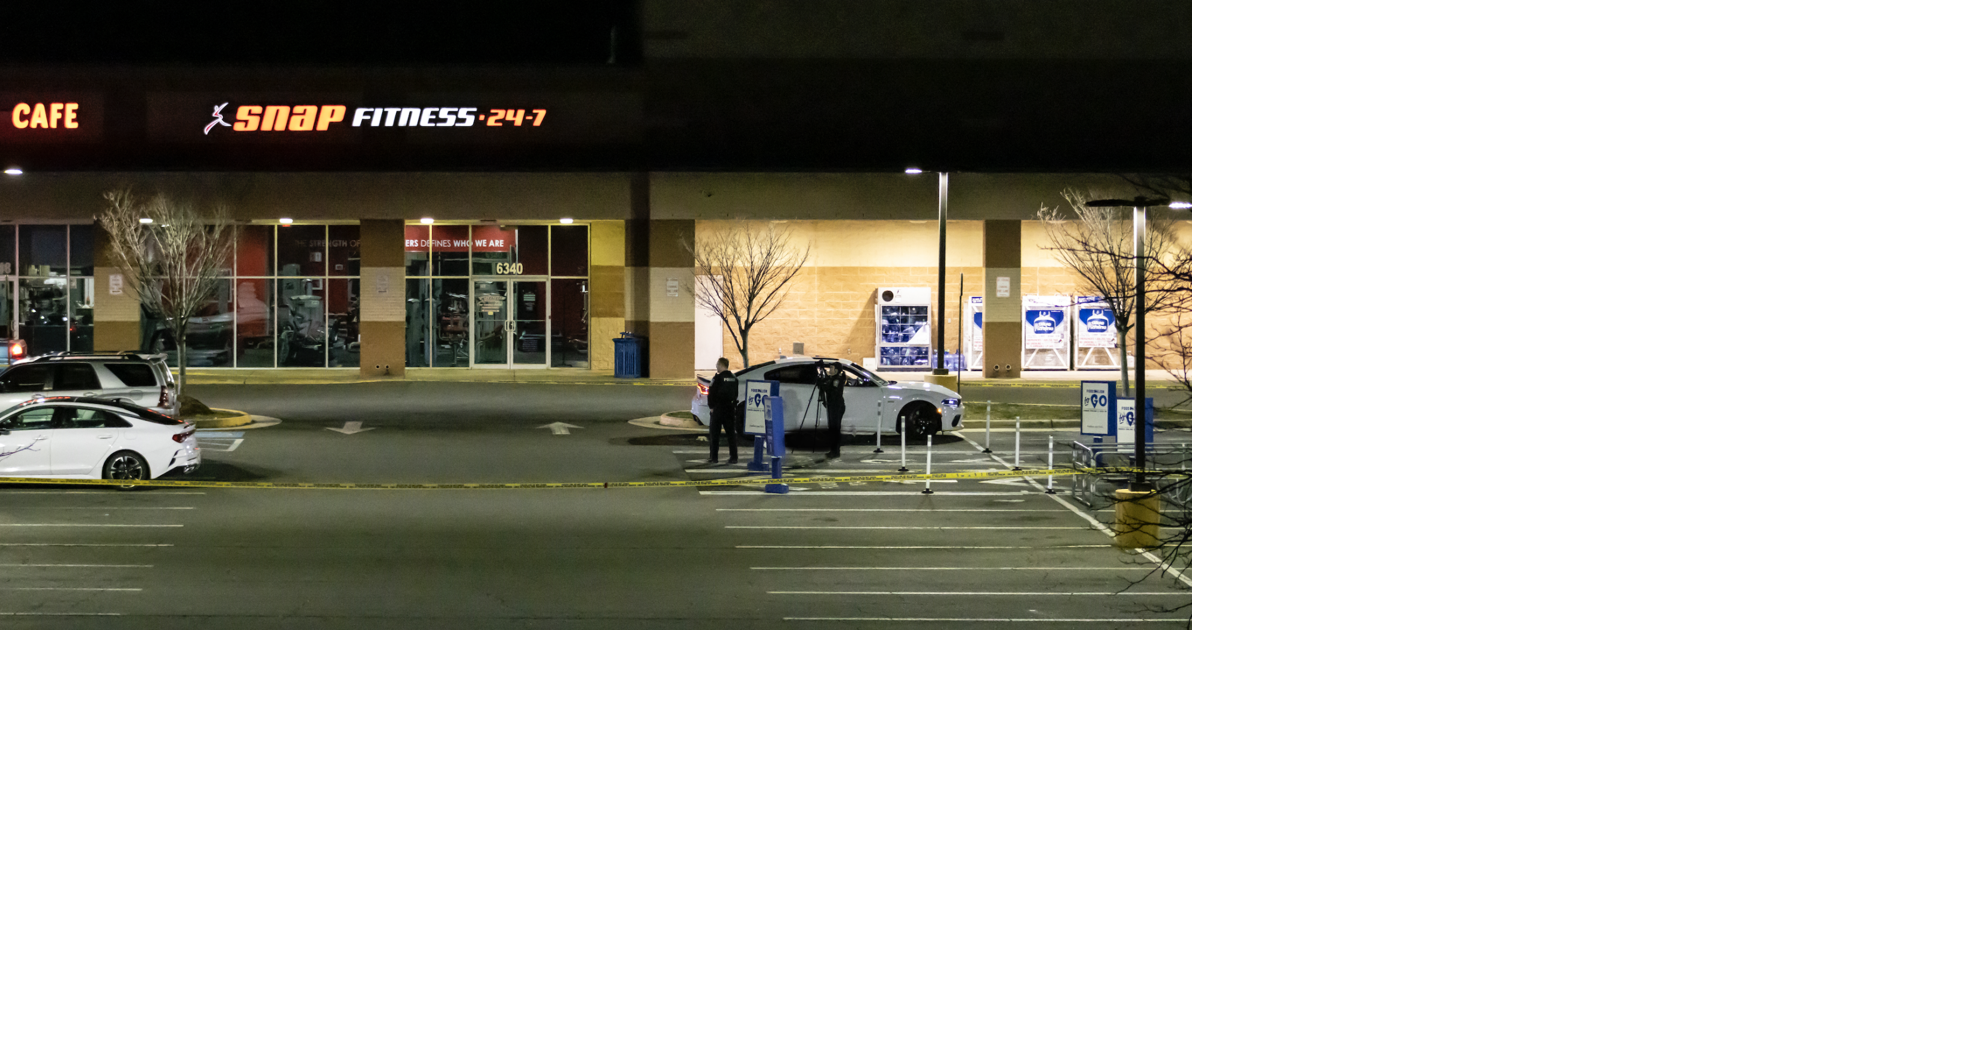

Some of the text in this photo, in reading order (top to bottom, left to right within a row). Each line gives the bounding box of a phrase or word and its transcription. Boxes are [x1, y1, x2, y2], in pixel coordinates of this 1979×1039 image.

[12, 102, 79, 129] CAFE
[351, 107, 478, 127] FITNESS
[488, 239, 505, 247] ARE
[496, 263, 523, 274] 6340
[1090, 394, 1107, 409] GO
